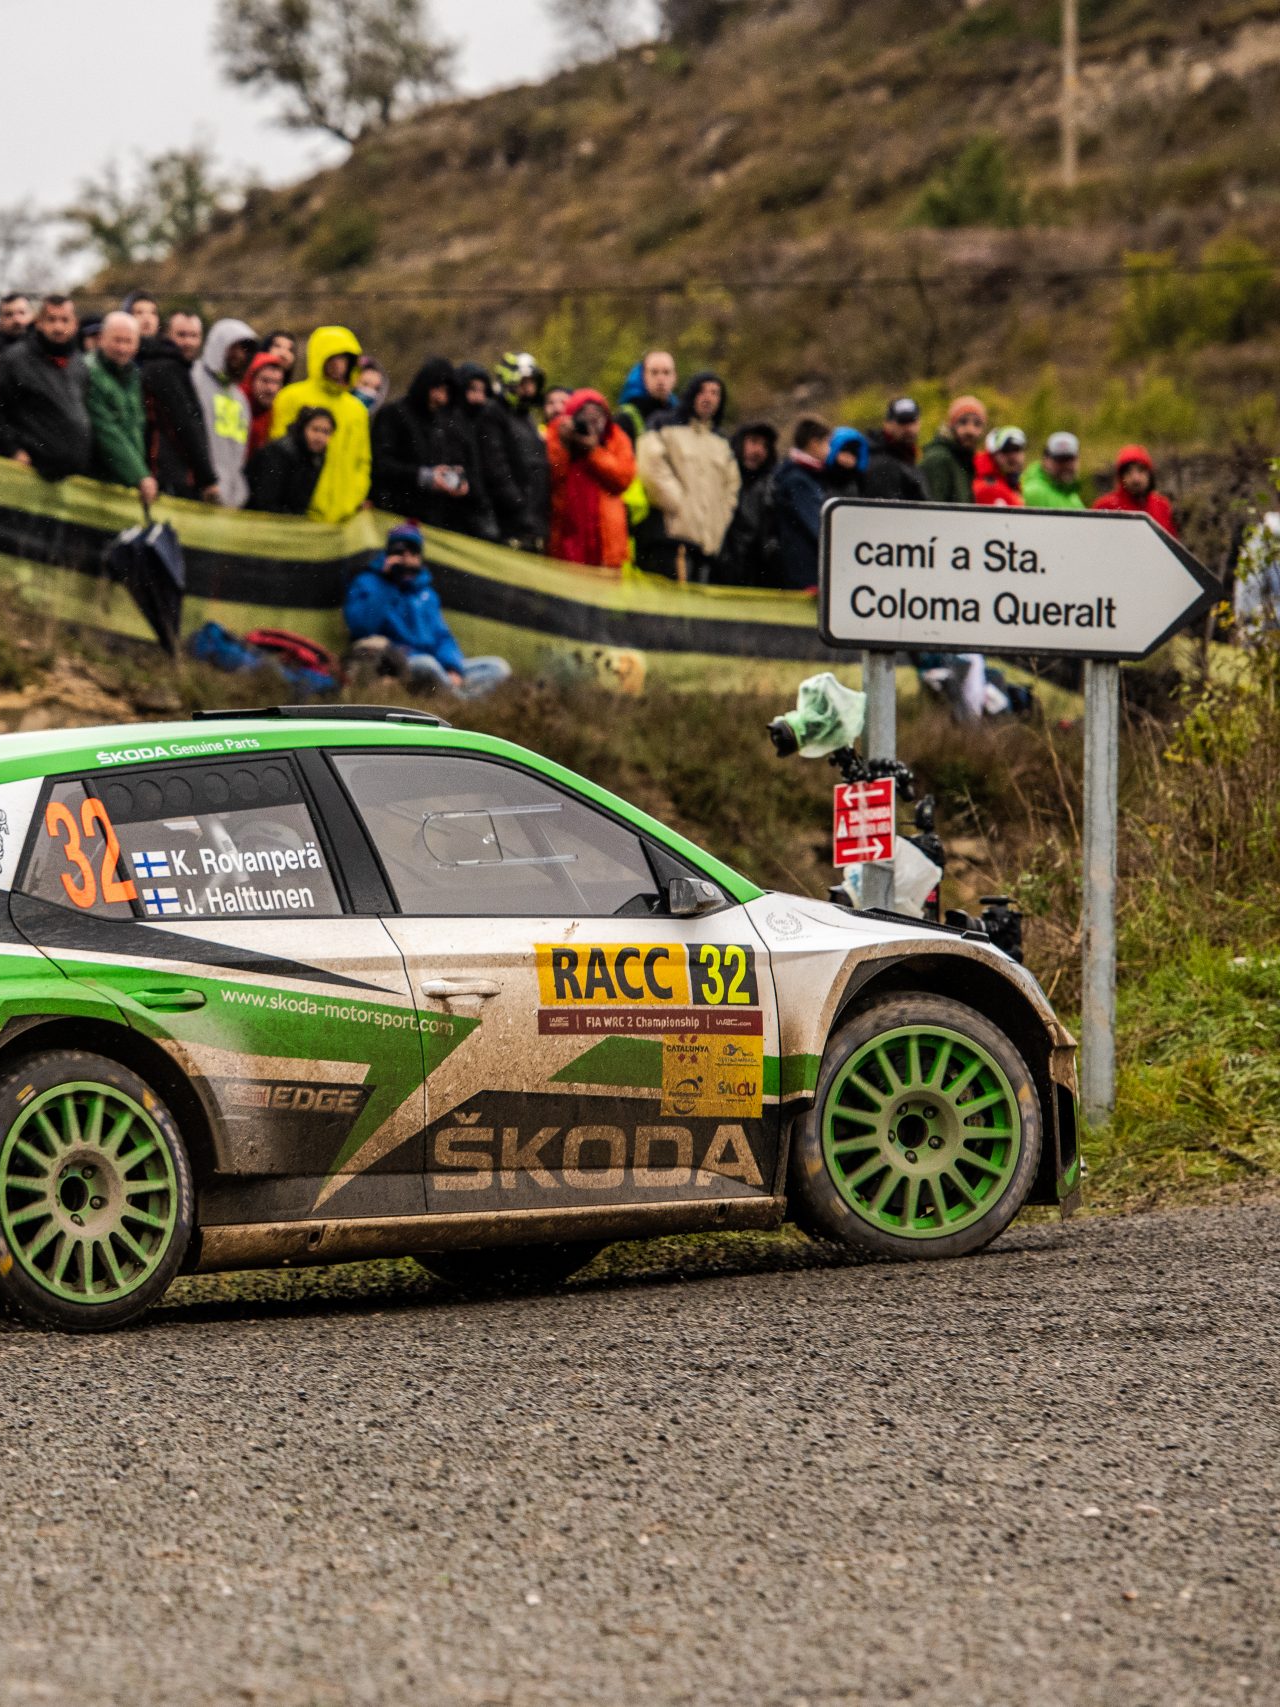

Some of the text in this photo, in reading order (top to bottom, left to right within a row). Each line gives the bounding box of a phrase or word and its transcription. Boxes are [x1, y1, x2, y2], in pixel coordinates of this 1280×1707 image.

[854, 536, 1047, 575] camí a Sta.
[850, 584, 1117, 629] Coloma Queralt
[96, 737, 261, 765] ŠKODA Genuine Parts
[45, 797, 138, 909] 32
[170, 842, 322, 878] K. Rovanperä
[184, 886, 315, 915] J. Halttunen
[550, 944, 751, 1005] RACC 32
[221, 989, 455, 1036] www.skoda-motorsport.com
[585, 1016, 700, 1030] FIA WRC 2 Championship
[666, 1044, 710, 1053] CATALUNYA
[270, 1085, 364, 1114] EDGE
[432, 1110, 764, 1192] ŠKODA
